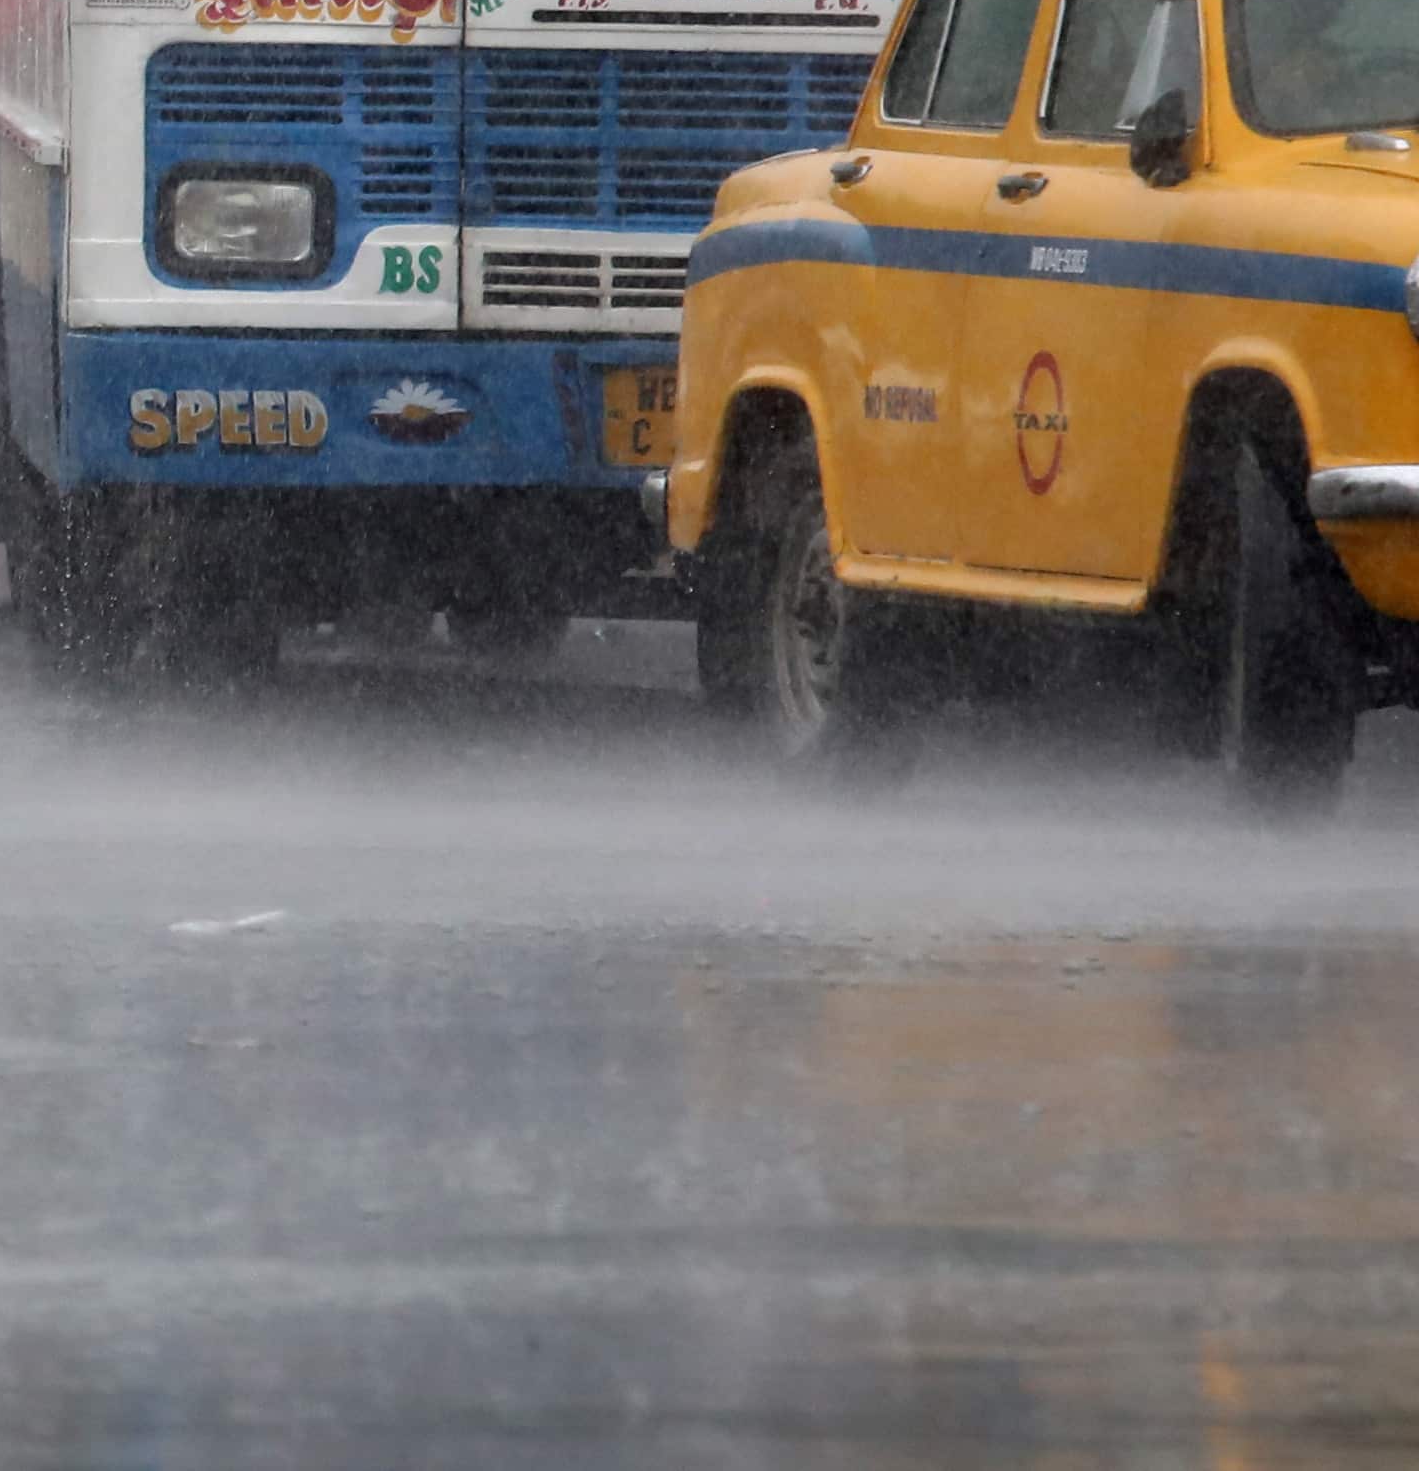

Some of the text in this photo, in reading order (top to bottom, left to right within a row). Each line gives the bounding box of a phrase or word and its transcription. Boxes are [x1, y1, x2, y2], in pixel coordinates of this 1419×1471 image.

[379, 245, 443, 293] BS
[129, 389, 329, 452] SPEED
[1014, 412, 1068, 432] TAXI
